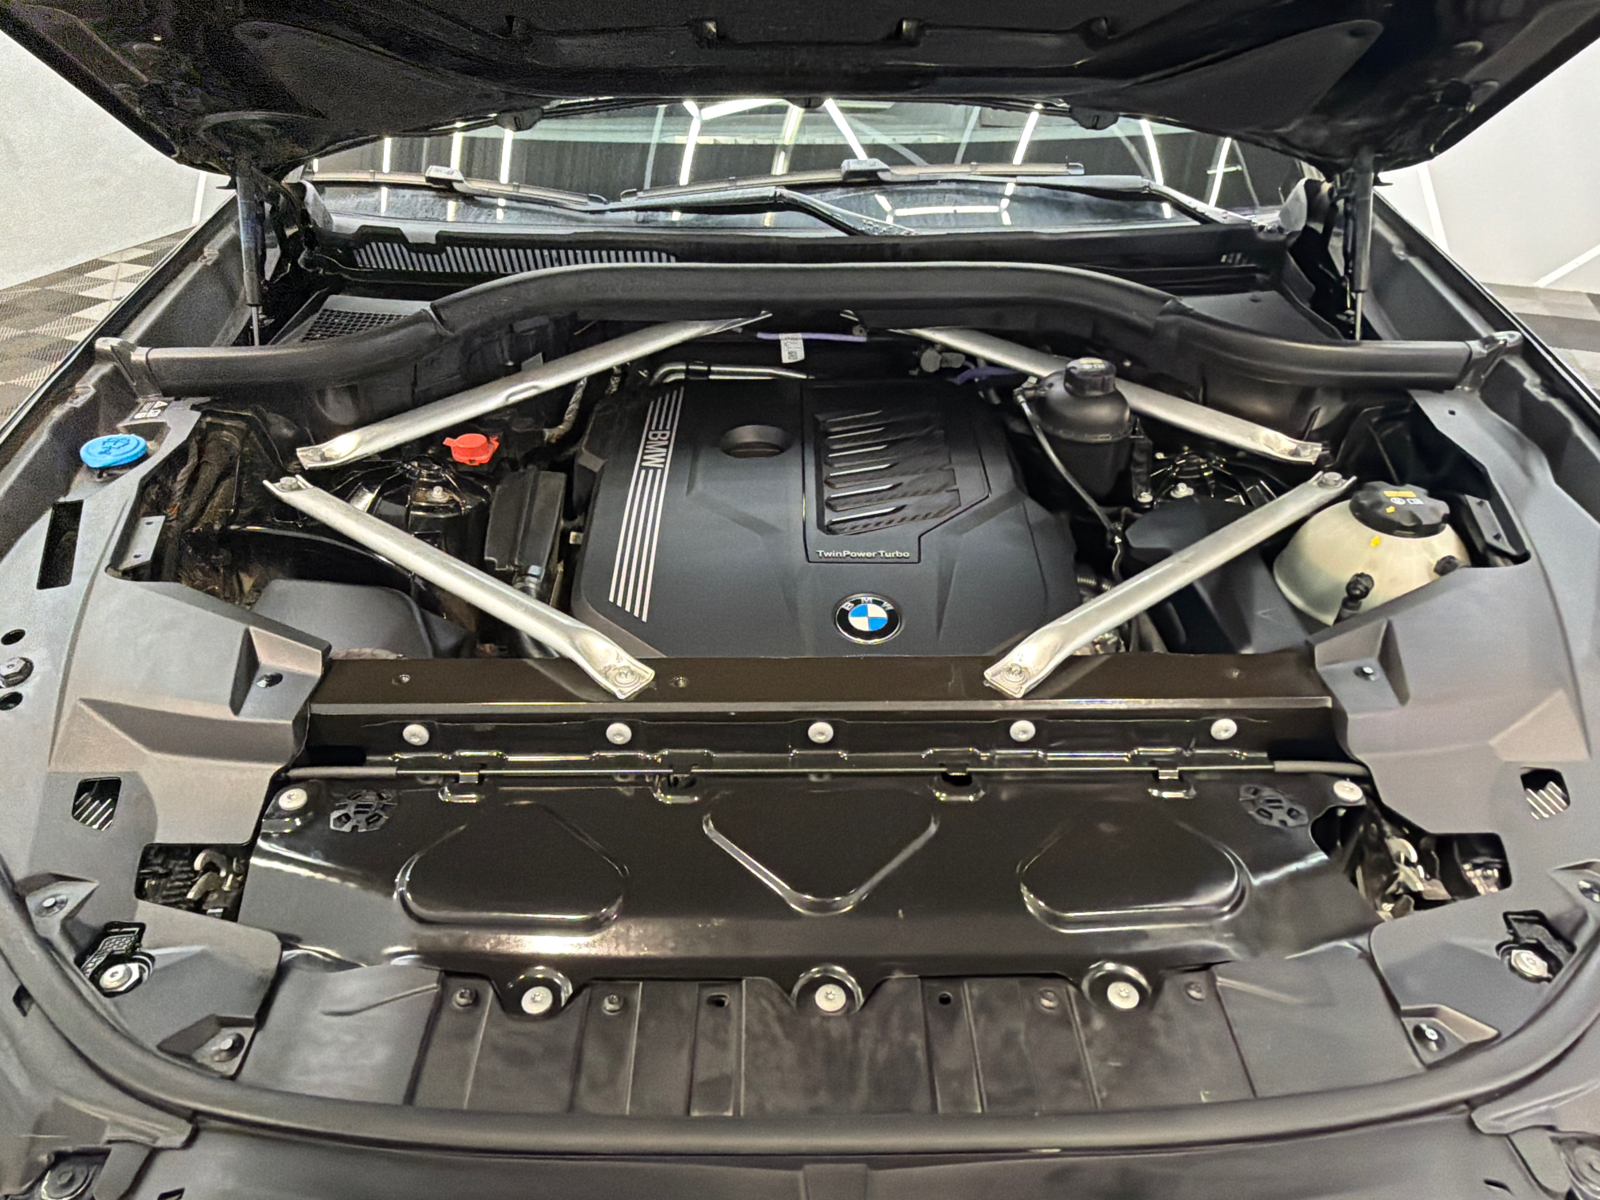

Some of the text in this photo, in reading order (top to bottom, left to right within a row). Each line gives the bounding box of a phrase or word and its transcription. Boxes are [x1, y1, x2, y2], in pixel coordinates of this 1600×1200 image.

[641, 431, 671, 468] BMW
[816, 549, 910, 558] TwinPower Turbo
[841, 597, 895, 611] BMW
